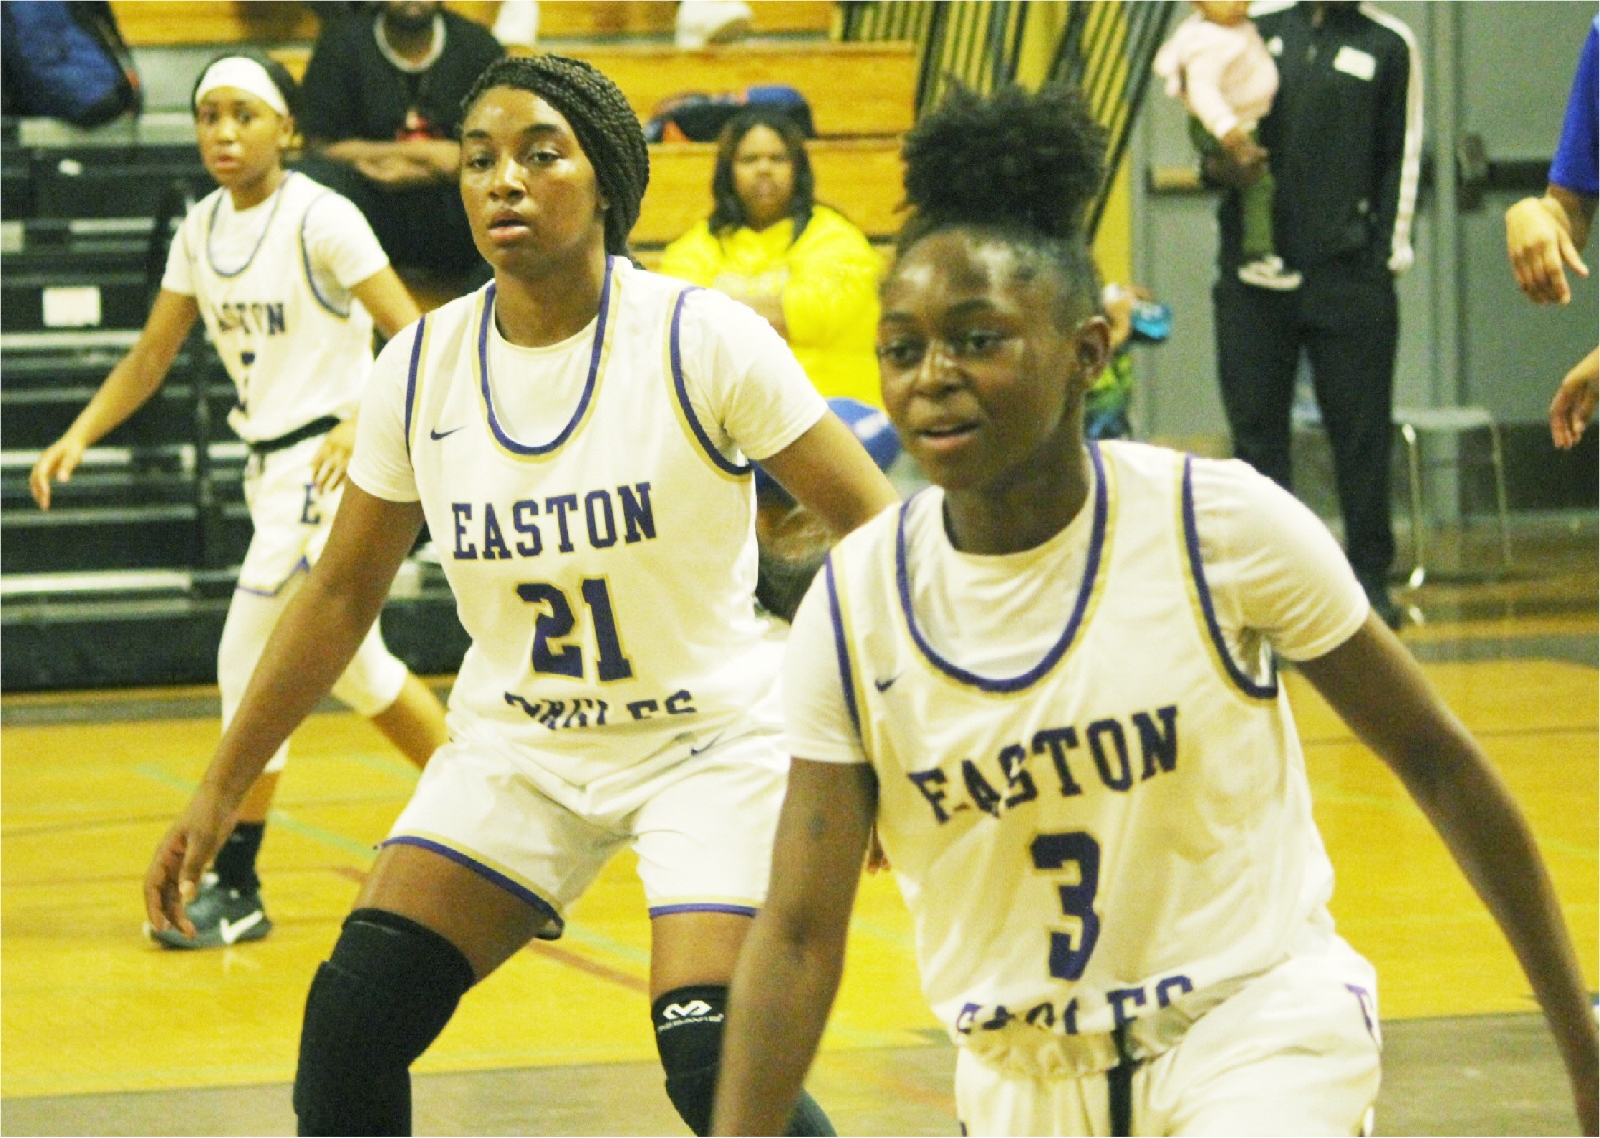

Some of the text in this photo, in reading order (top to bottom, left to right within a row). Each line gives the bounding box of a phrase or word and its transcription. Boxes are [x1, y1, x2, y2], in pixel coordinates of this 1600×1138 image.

[300, 484, 321, 524] E
[451, 481, 657, 560] EASTON
[515, 576, 634, 682] 21
[906, 705, 1178, 825] EASTON
[1029, 831, 1101, 982] 3
